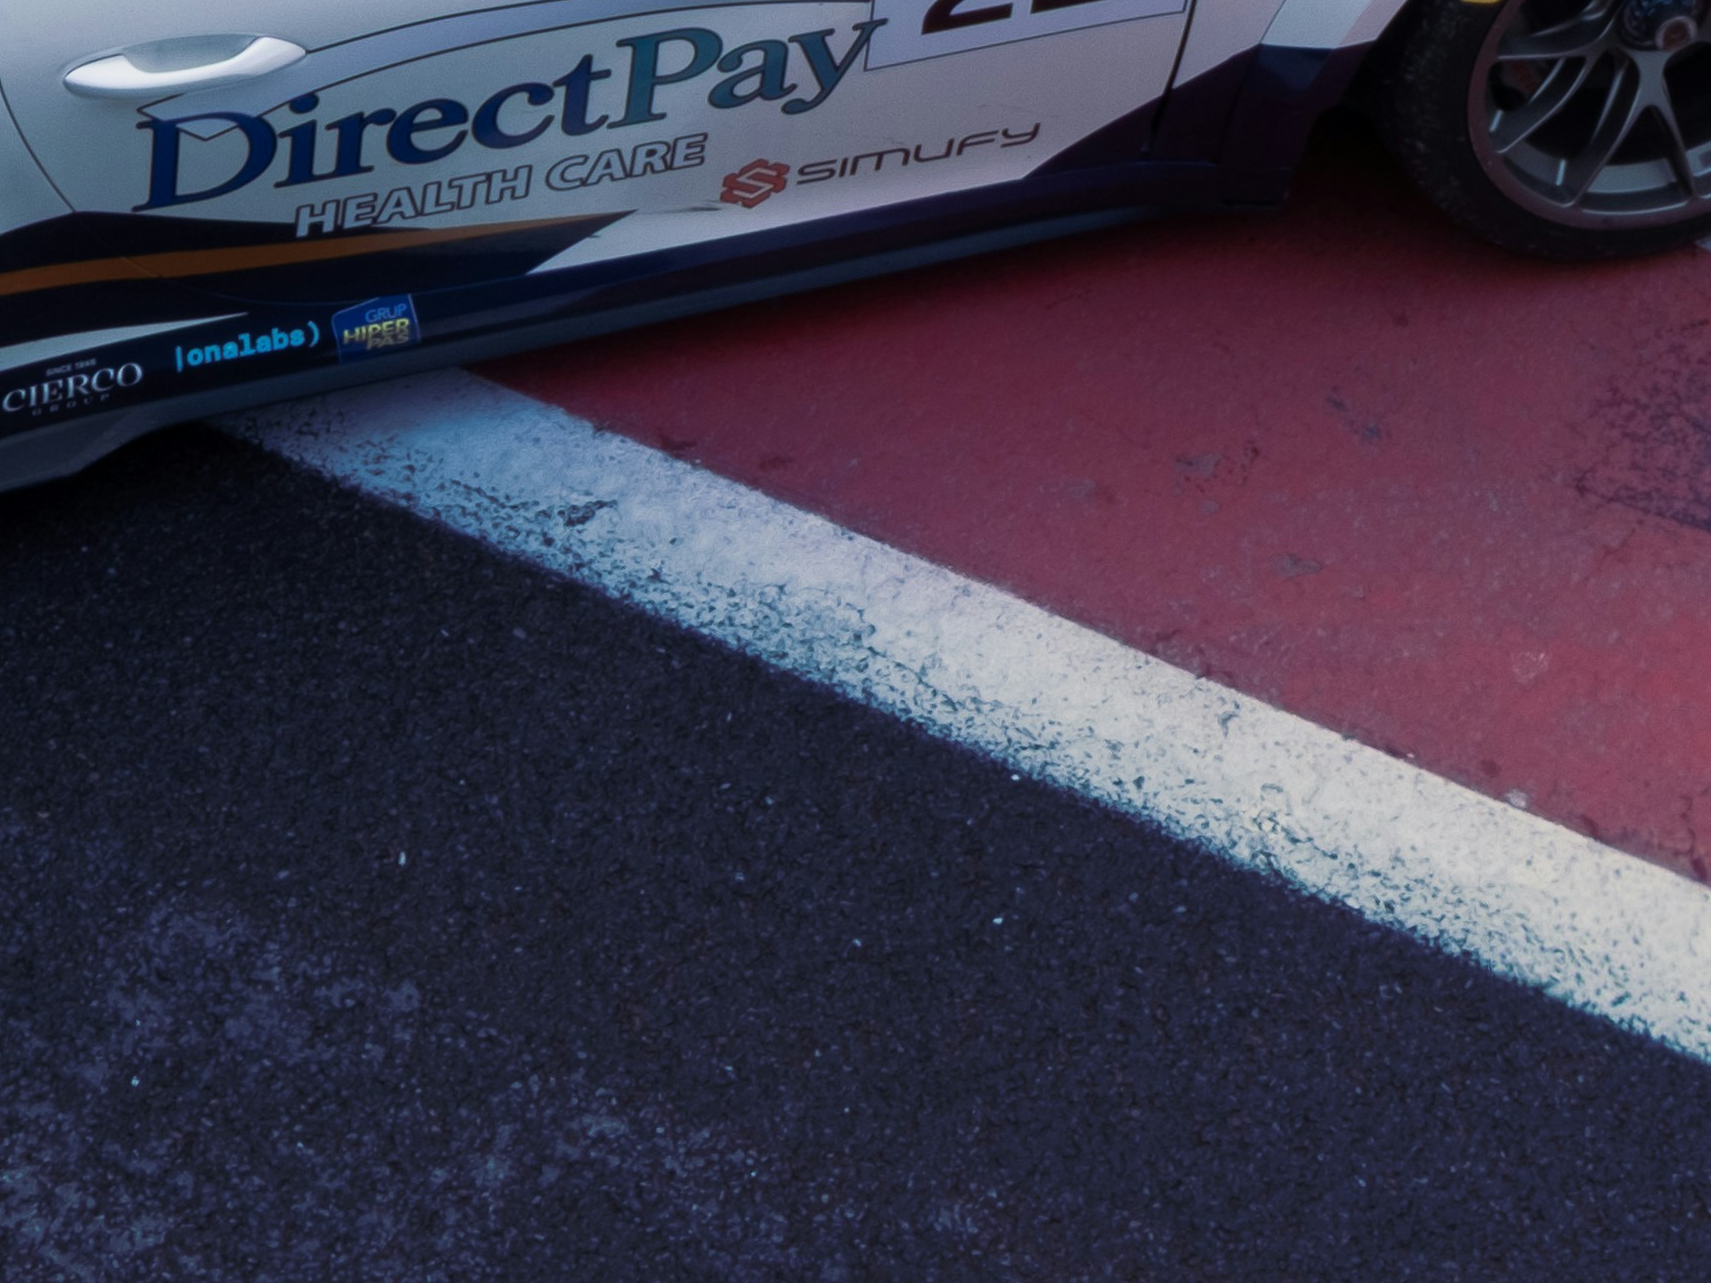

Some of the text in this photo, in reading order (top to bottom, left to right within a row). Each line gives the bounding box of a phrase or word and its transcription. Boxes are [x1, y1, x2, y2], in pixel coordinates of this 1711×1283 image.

[131, 17, 888, 213] DirectPay
[795, 122, 1041, 186] SIMUFY
[296, 133, 708, 237] HEALTH CARE
[2, 361, 144, 413] CIERCO
